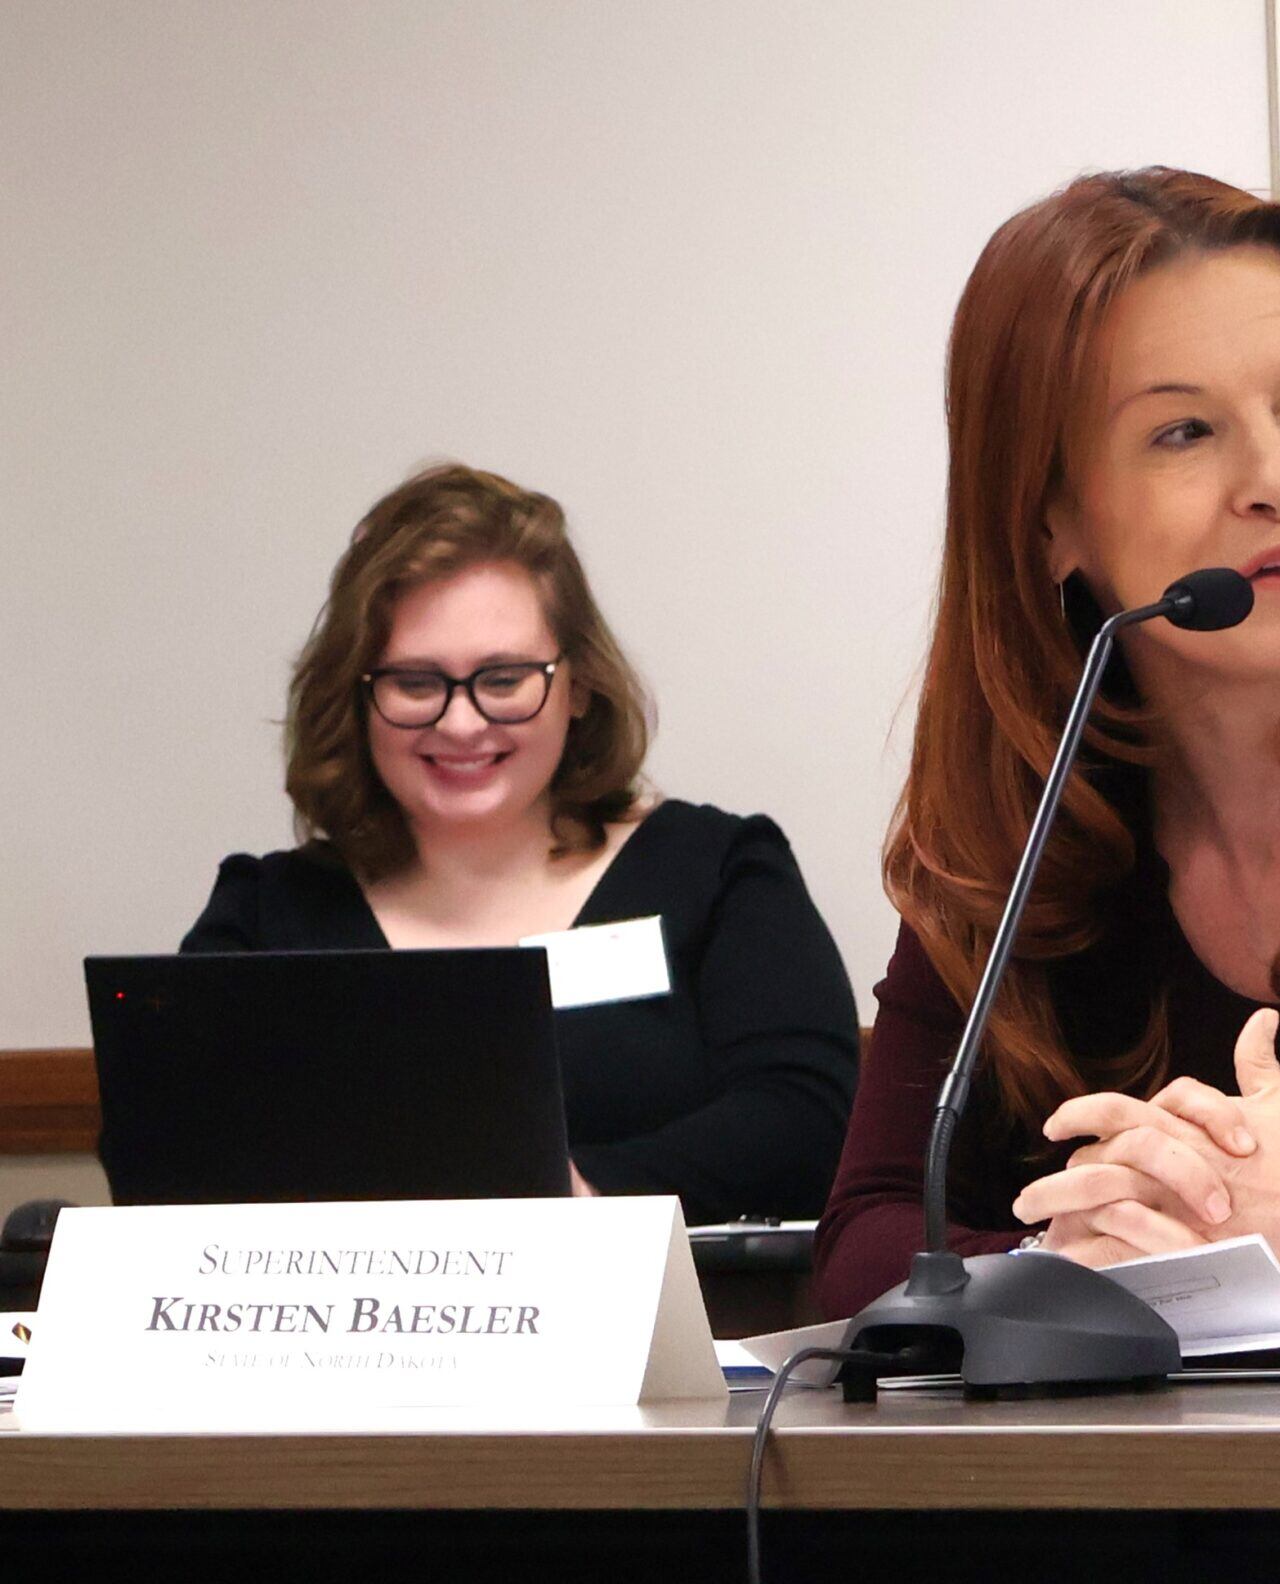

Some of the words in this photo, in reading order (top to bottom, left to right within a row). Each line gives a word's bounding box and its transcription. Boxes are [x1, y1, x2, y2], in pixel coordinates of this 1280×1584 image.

[198, 1243, 514, 1276] SUPERINTENDENT
[144, 1296, 335, 1333] KIRSTEN
[346, 1297, 540, 1335] BAESLER
